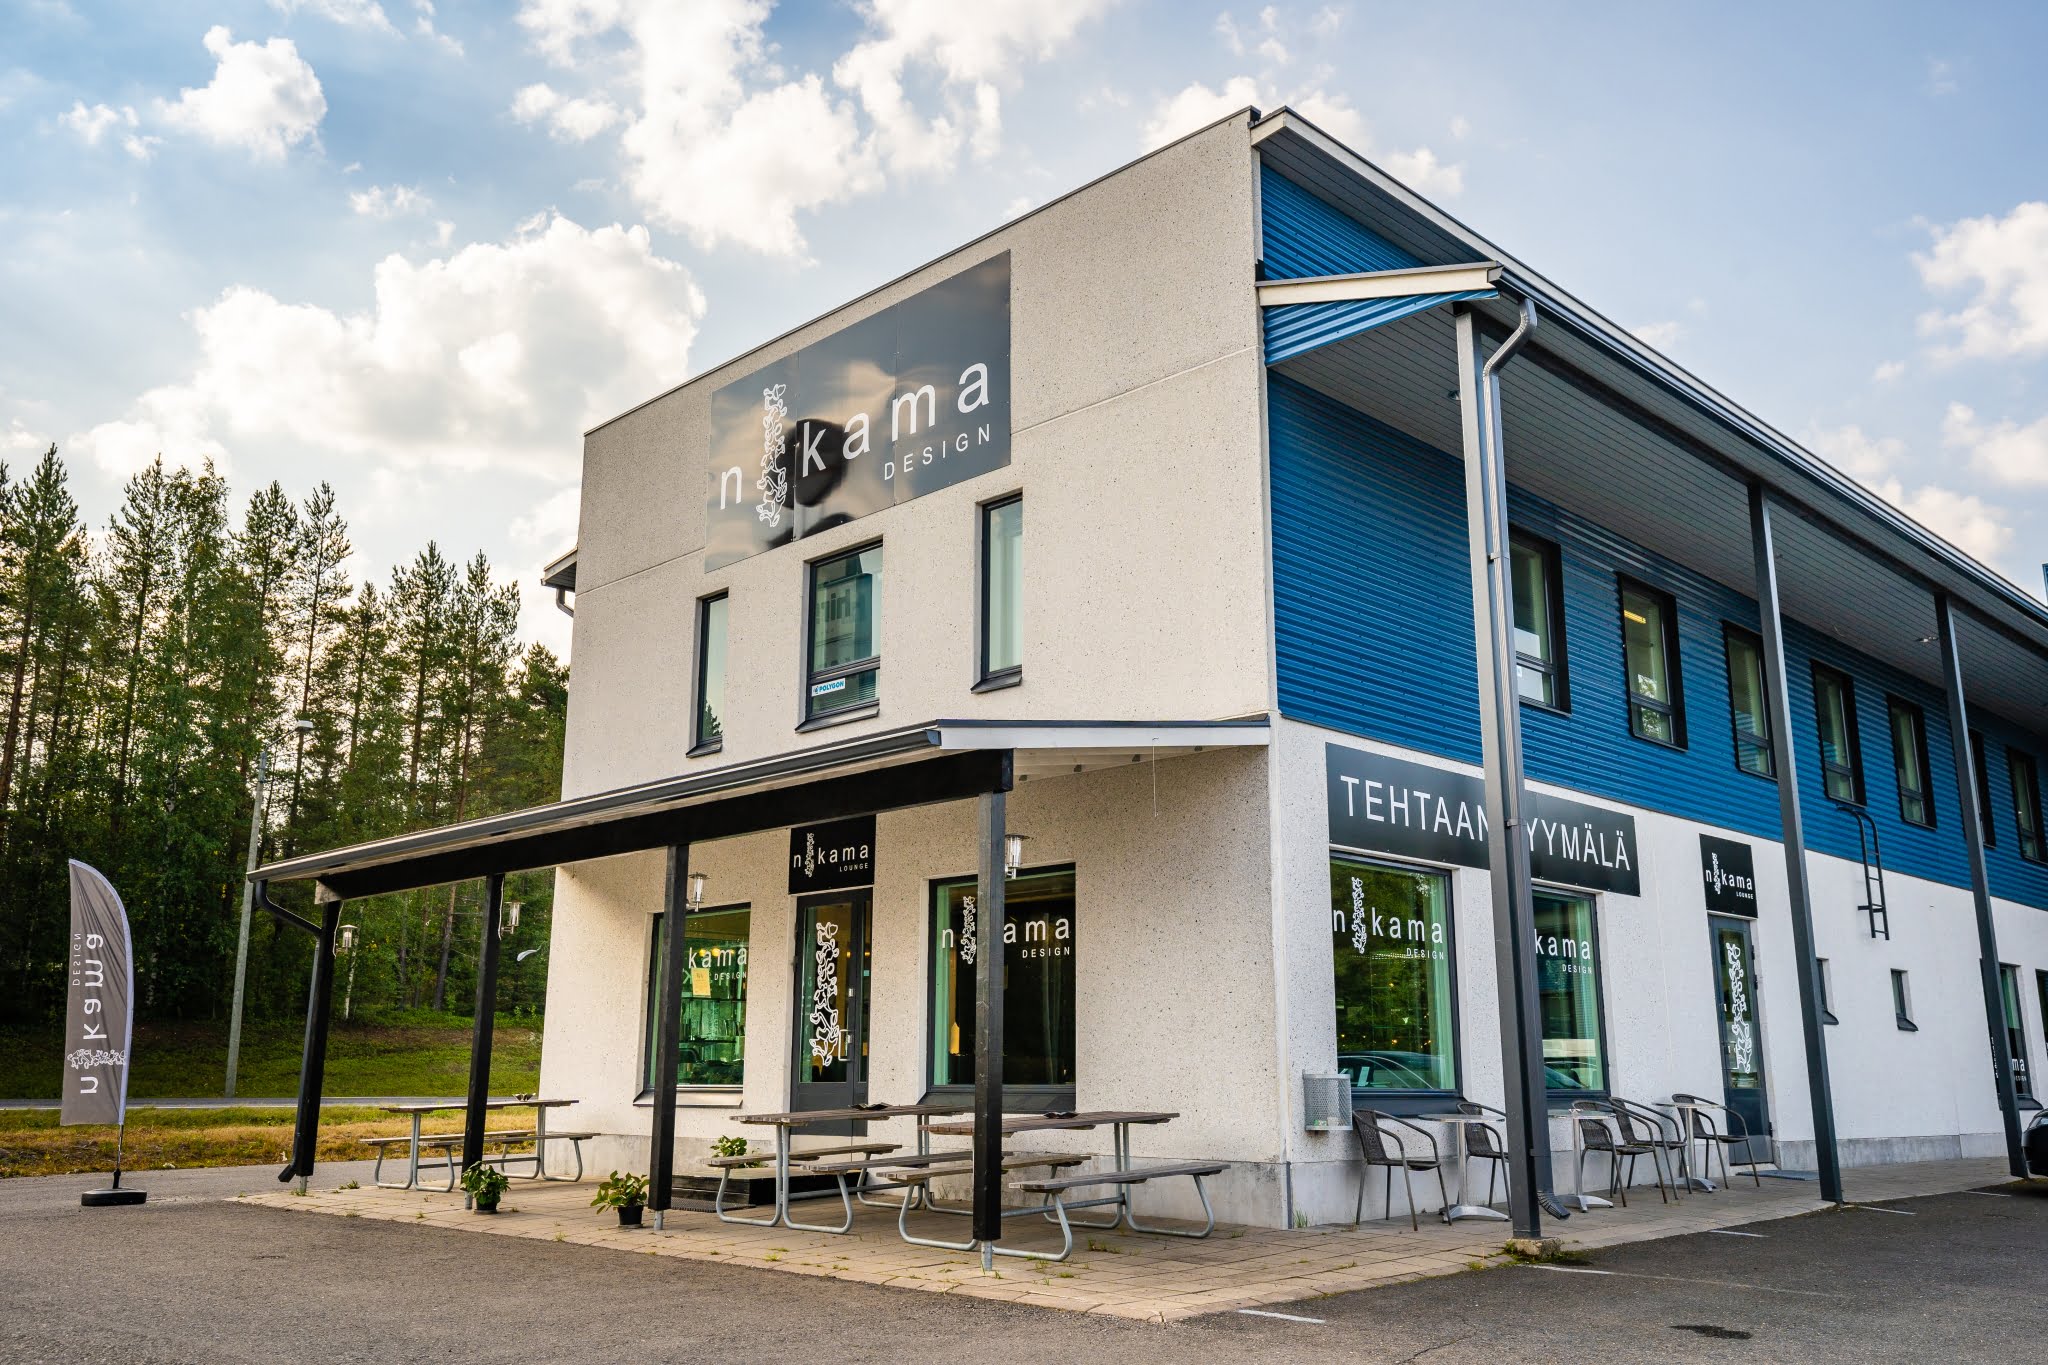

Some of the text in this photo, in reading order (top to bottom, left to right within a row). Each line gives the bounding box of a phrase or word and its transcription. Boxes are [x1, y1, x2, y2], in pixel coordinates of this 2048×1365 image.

[884, 423, 991, 480] DESIGN
[819, 681, 845, 692] POLYGON
[1340, 775, 1630, 871] TEHTAANYYMÄLÄ
[840, 863, 869, 872] LOUNGE
[1736, 891, 1754, 900] LOUNGE
[1022, 946, 1070, 958] DESIGN
[1406, 947, 1444, 960] DESIGN
[1562, 964, 1592, 974] DESIGN
[714, 971, 747, 981] DESIGN
